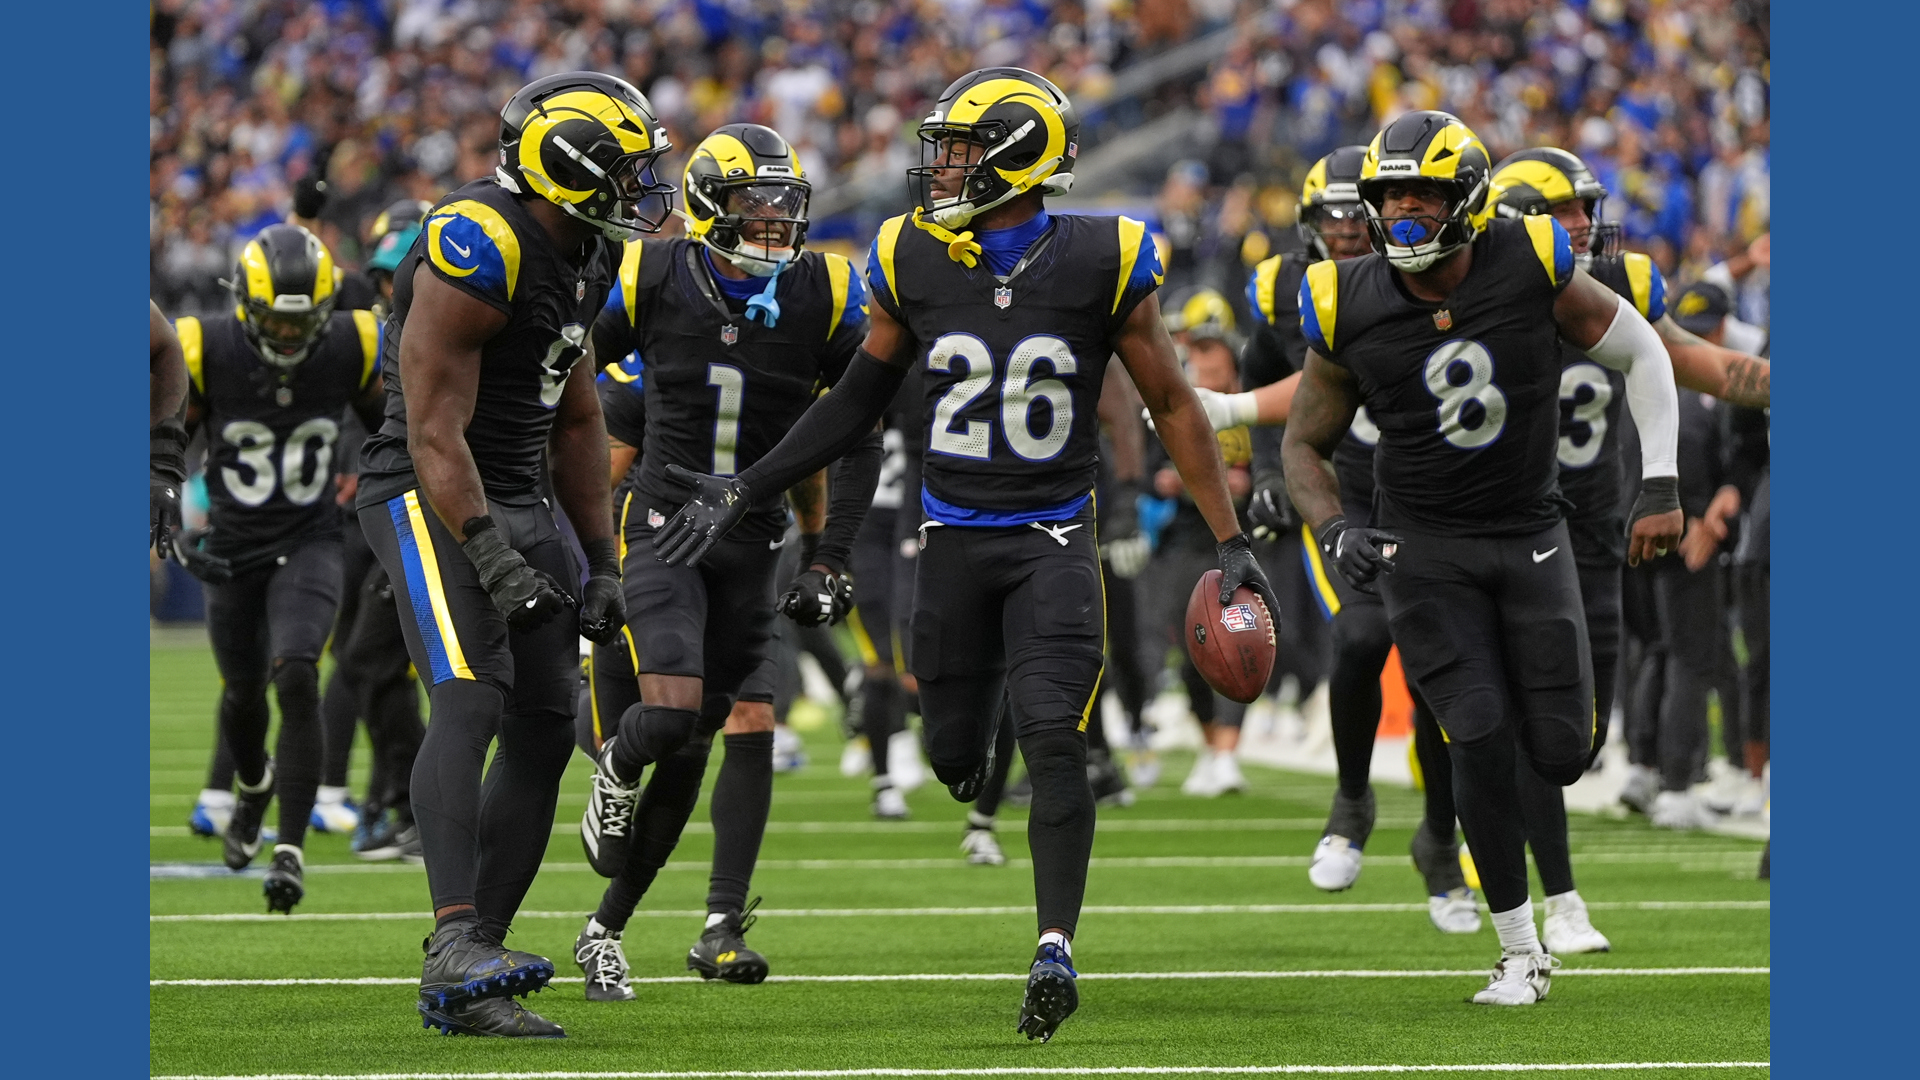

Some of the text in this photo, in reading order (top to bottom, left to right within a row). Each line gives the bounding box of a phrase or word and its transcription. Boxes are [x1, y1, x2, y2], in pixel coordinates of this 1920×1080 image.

[707, 362, 744, 476] 1
[927, 332, 1078, 461] 26
[1422, 338, 1509, 449] 8
[222, 418, 339, 507] 30
[1226, 608, 1243, 628] NFL
